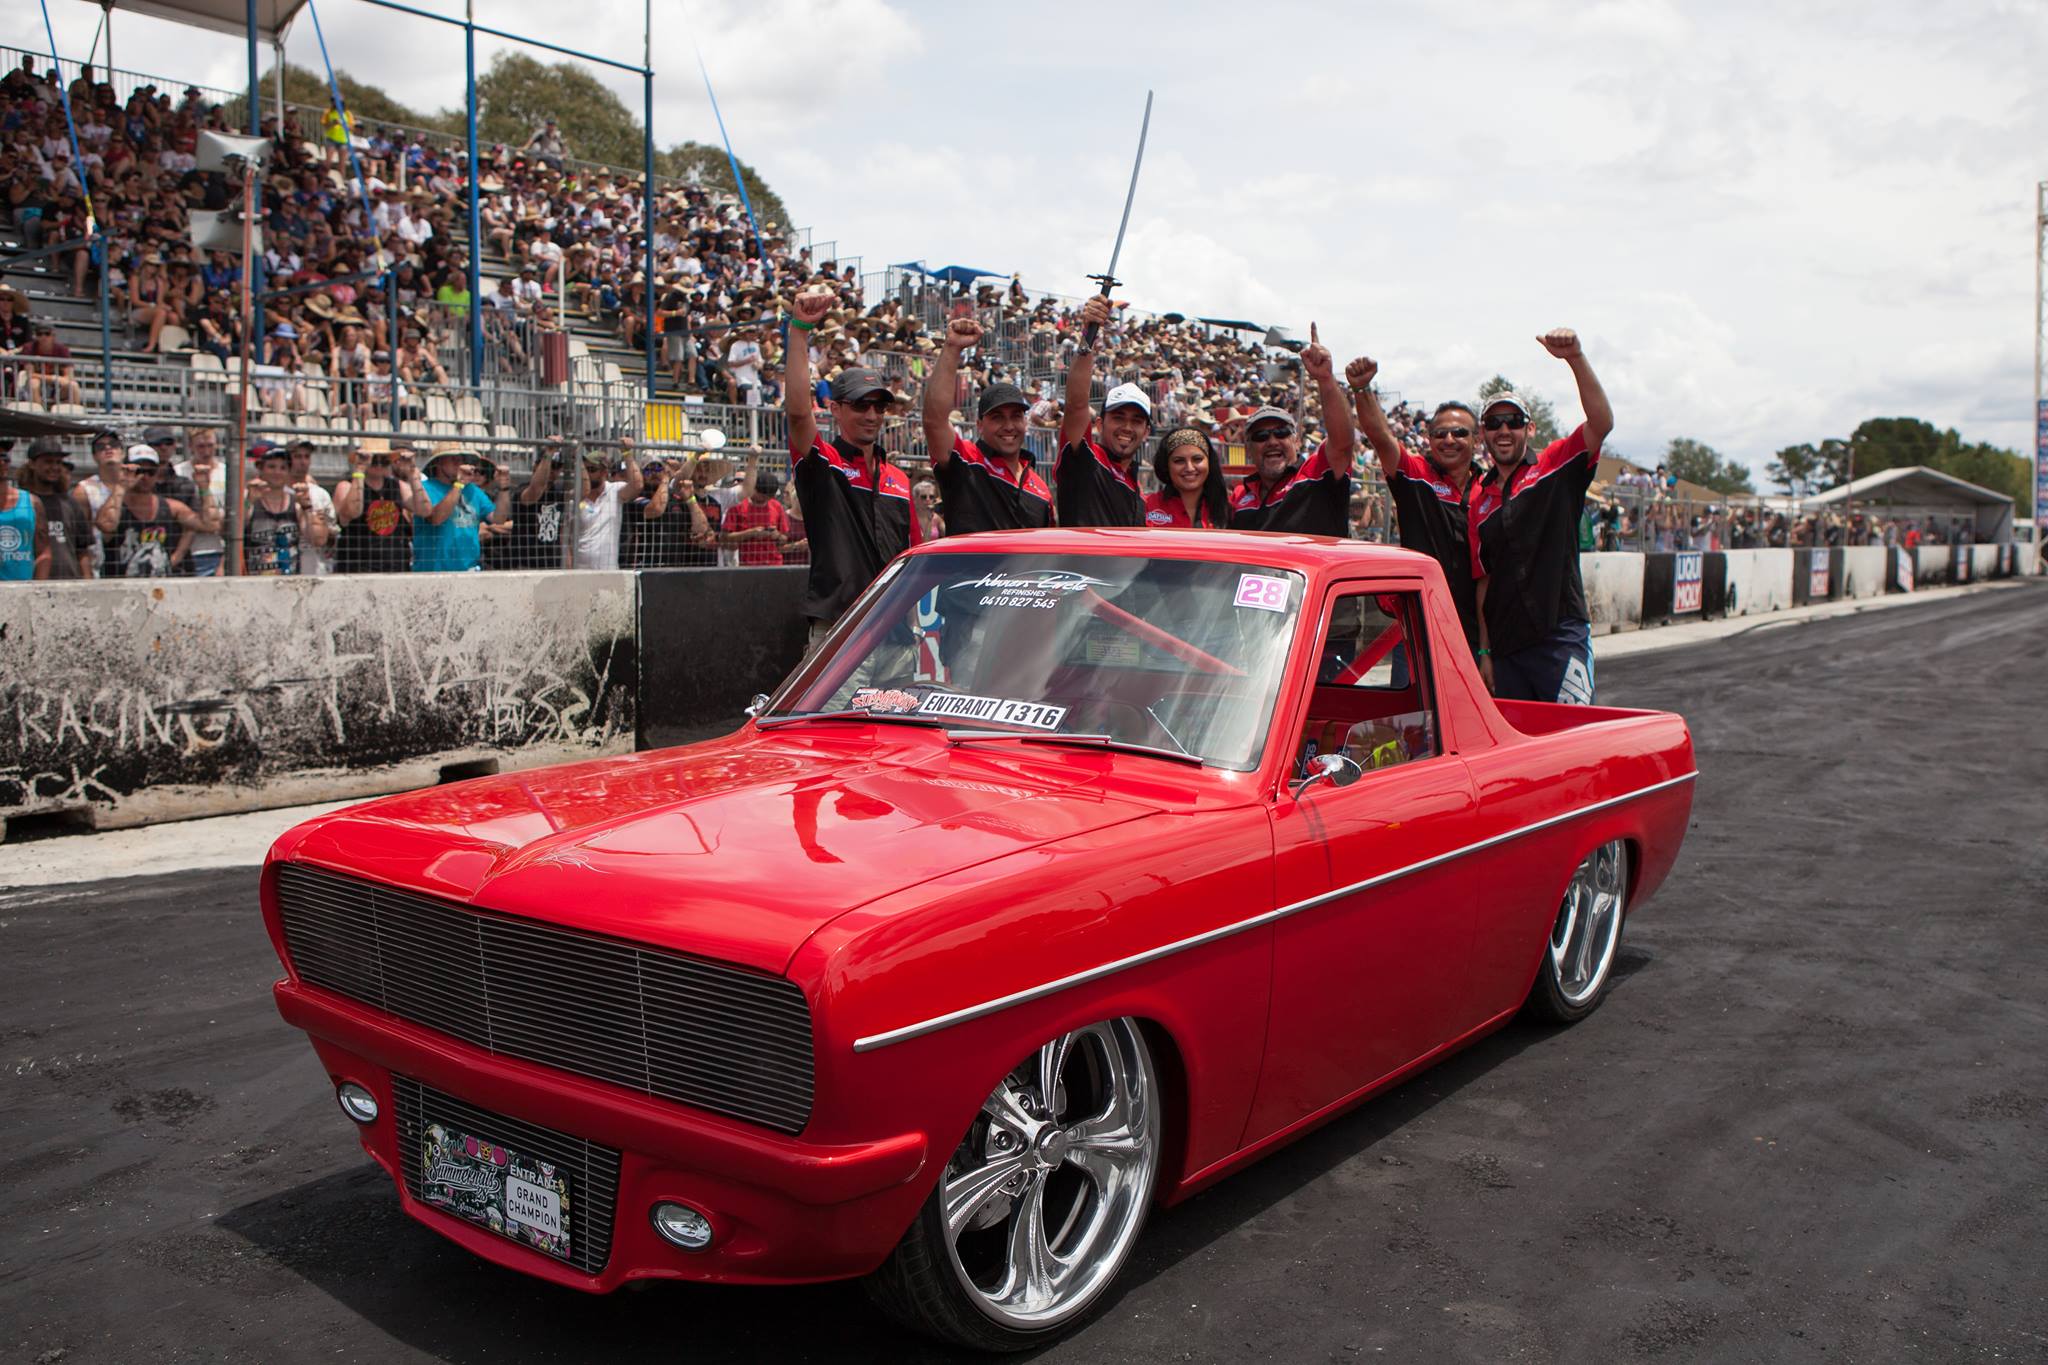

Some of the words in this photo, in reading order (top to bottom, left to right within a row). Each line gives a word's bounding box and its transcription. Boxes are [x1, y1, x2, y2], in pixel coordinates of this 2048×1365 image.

[1147, 511, 1173, 523] DATSUN
[979, 595, 1008, 606] 0410
[1009, 597, 1032, 607] 827
[1032, 598, 1057, 609] 545
[1001, 588, 1048, 597] REFINISHES
[1241, 579, 1282, 605] 28
[924, 695, 997, 718] ENTRANT
[1004, 702, 1060, 726] 1316
[510, 1163, 560, 1190] ENTRANT
[516, 1186, 548, 1209] GRAND
[508, 1199, 557, 1230] CHAMPION
